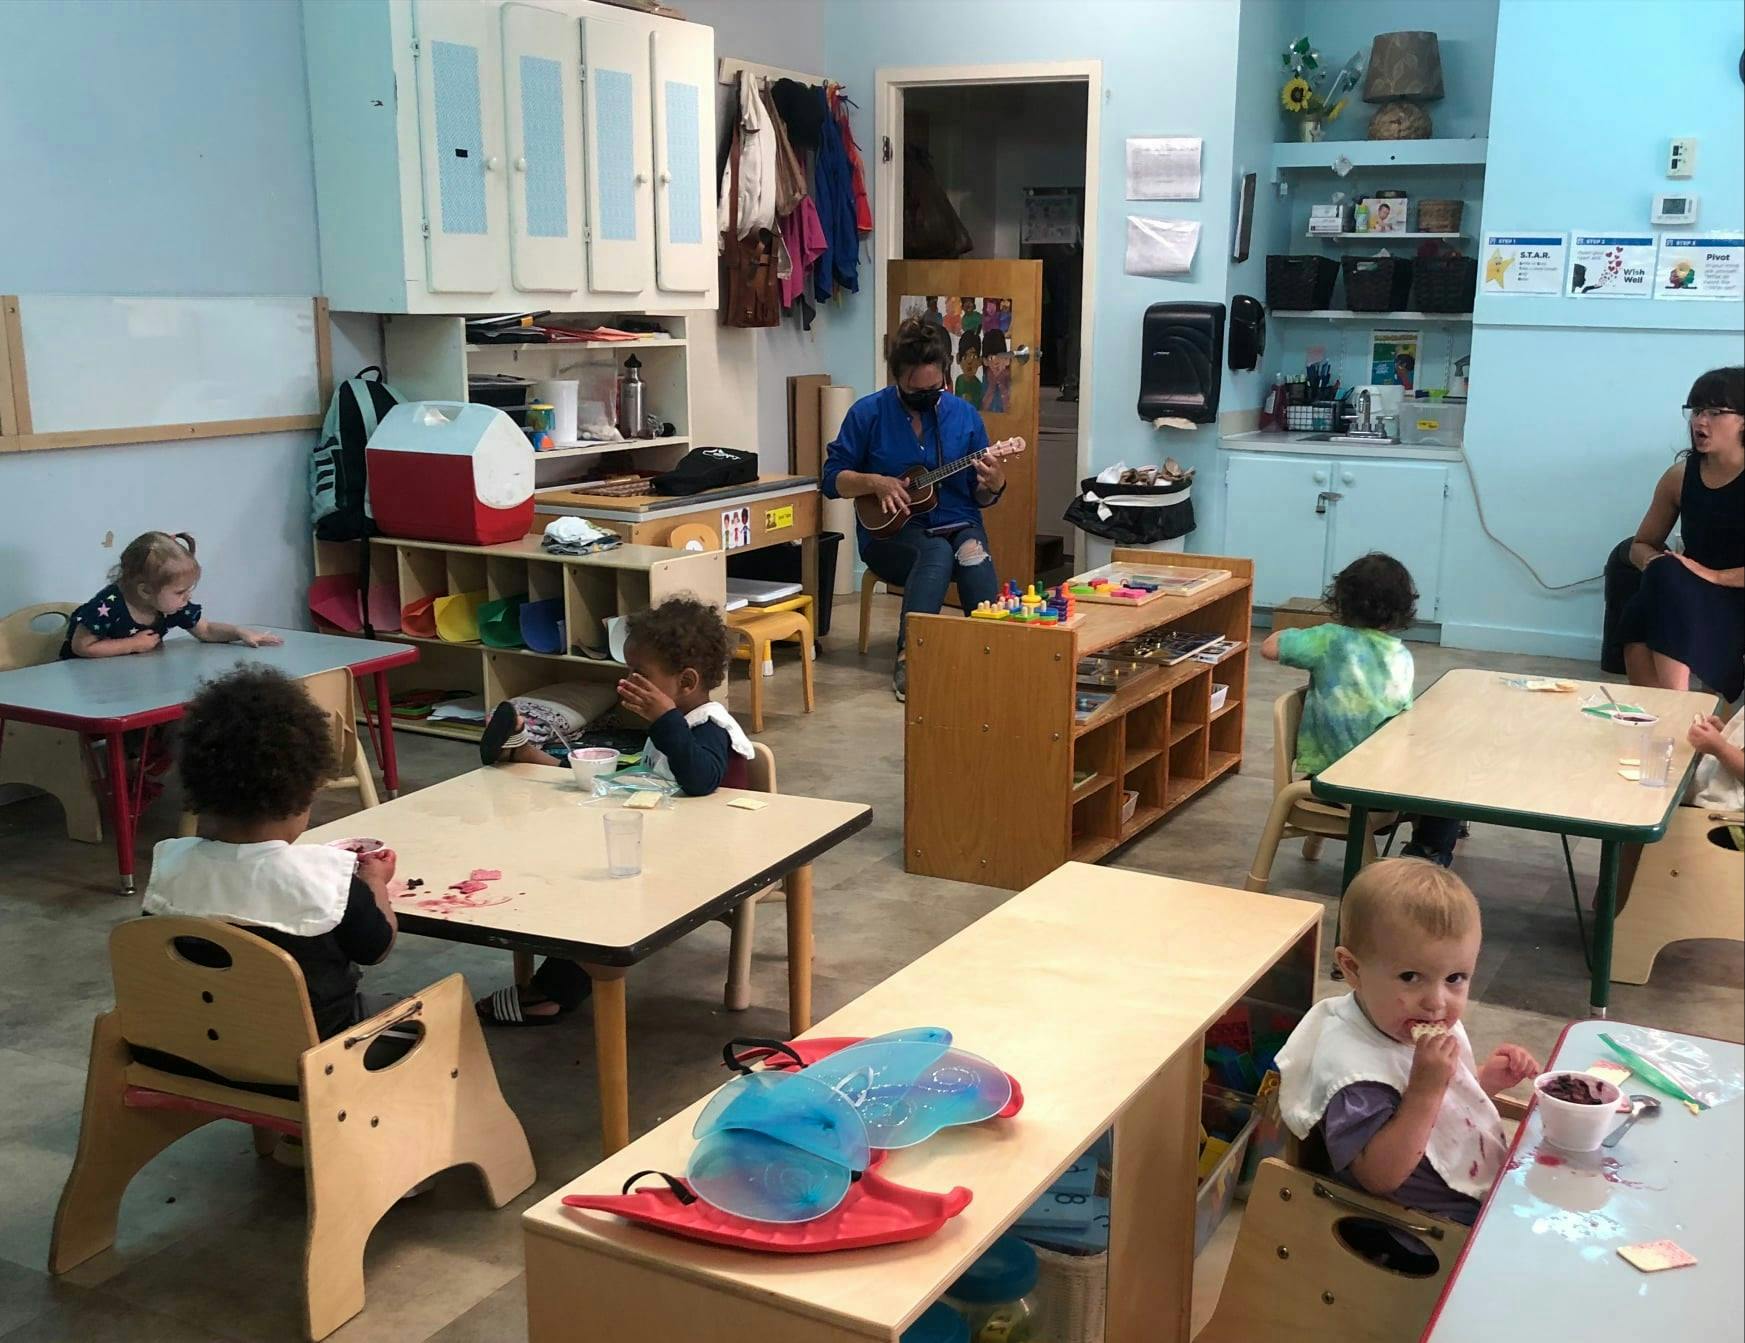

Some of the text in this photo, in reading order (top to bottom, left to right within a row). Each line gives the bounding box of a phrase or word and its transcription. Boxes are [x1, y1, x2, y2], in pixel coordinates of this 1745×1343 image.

[1520, 251, 1550, 259] S.T.A.R.
[1706, 253, 1730, 261] Pivot
[1623, 276, 1643, 284] Well
